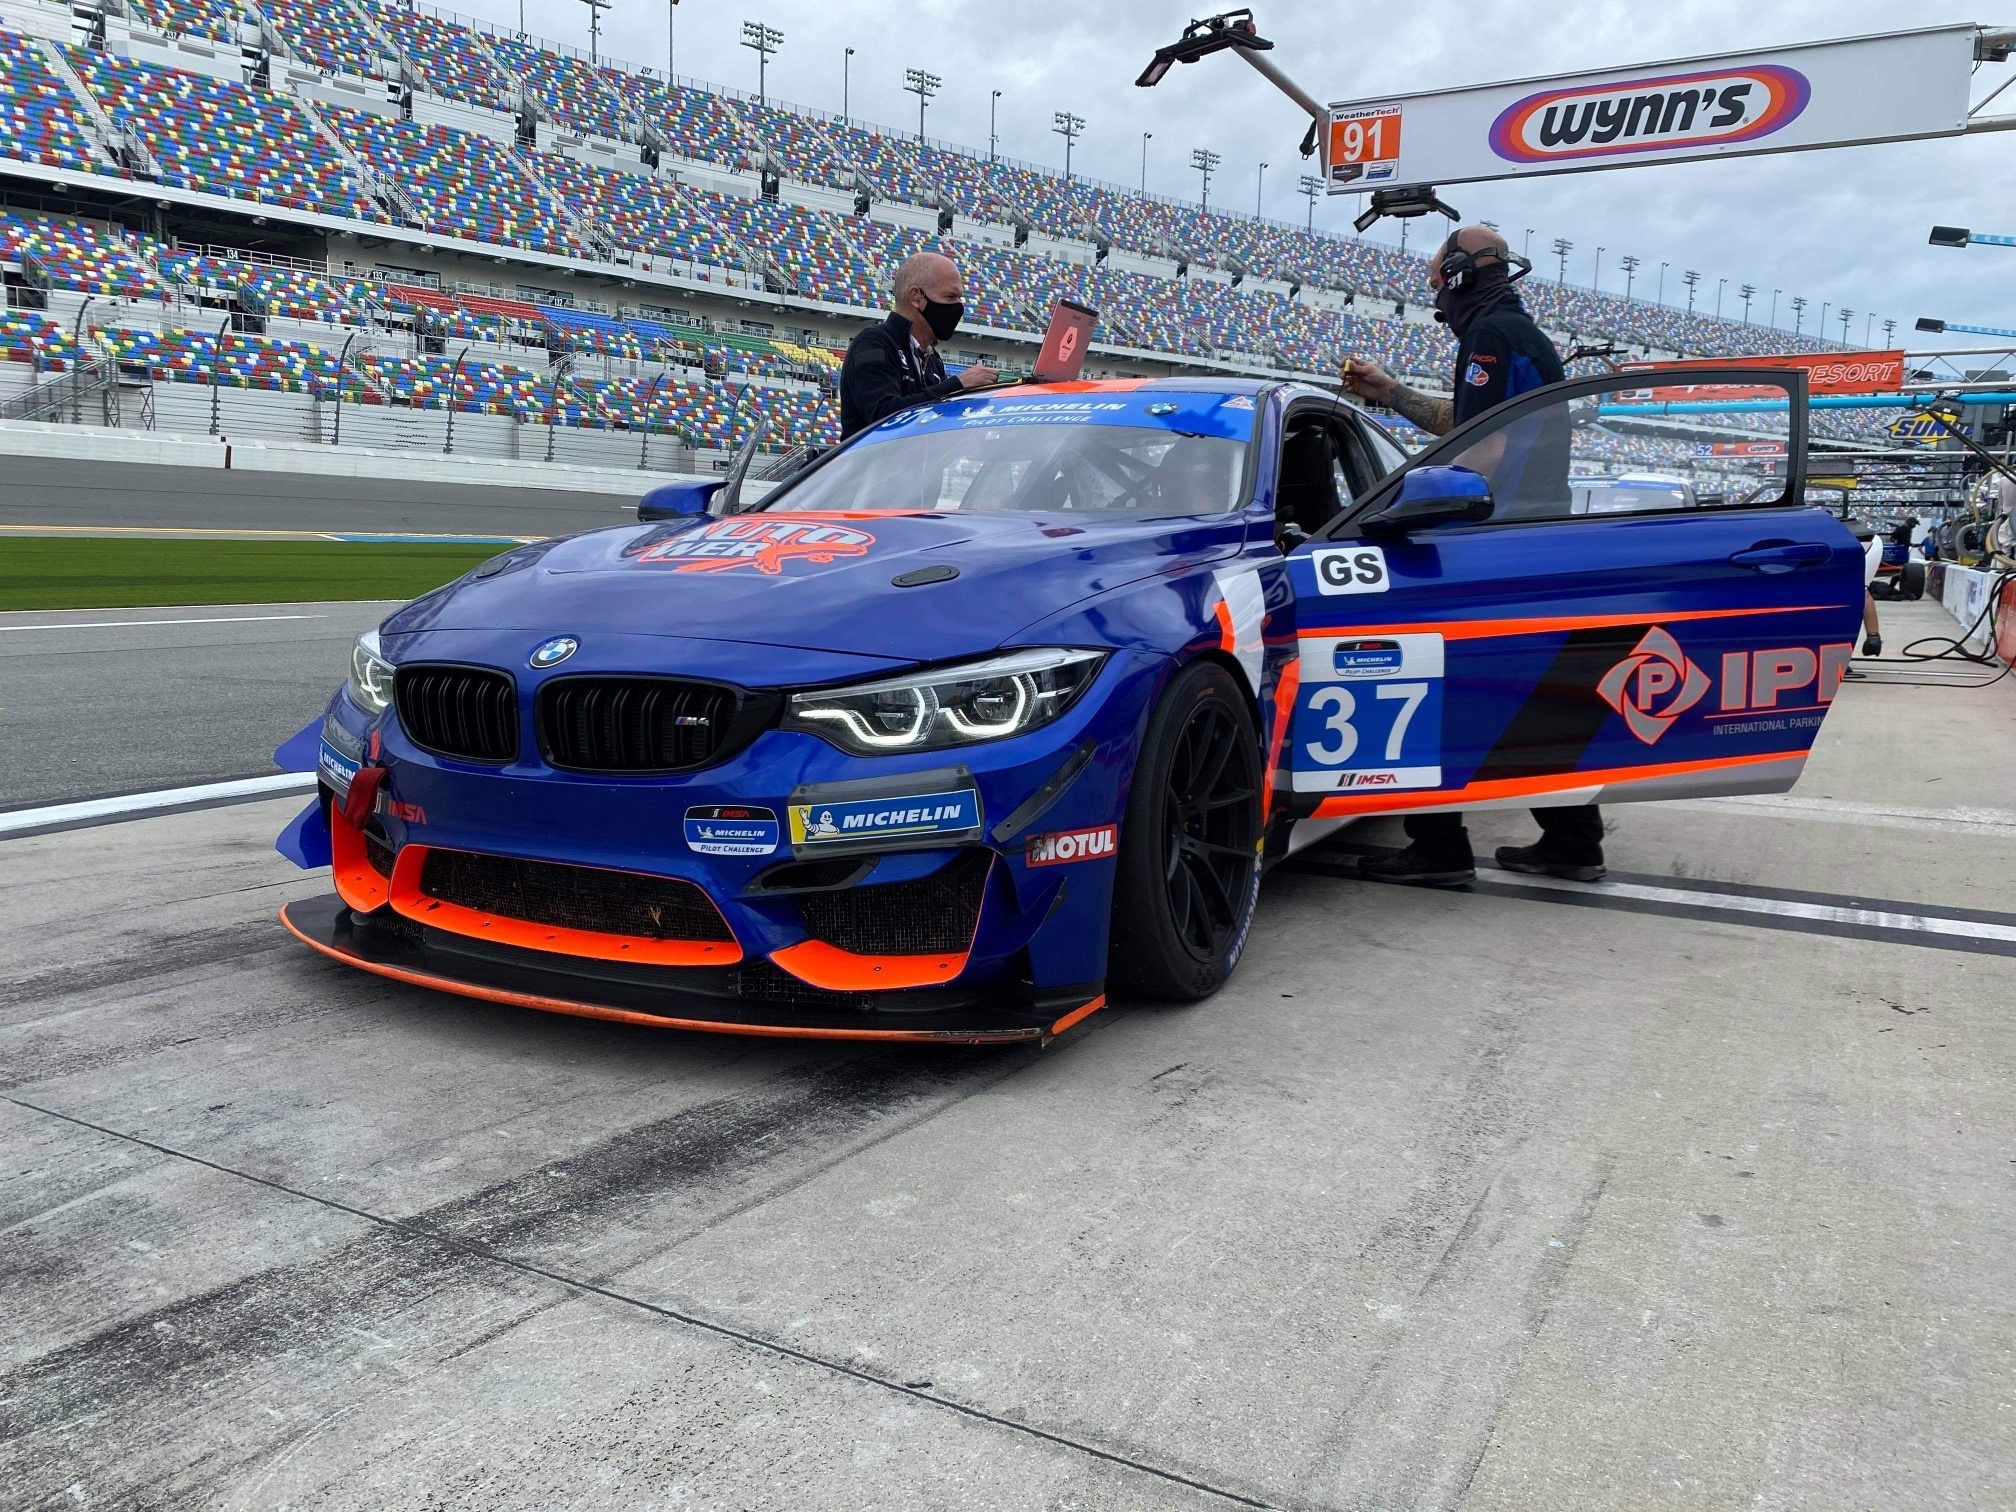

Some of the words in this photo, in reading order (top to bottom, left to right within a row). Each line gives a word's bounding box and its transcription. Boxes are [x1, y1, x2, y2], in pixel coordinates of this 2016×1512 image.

[1336, 107, 1398, 120] WeatherTech
[1343, 119, 1383, 162] 91
[227, 249, 239, 260] 134
[372, 270, 383, 281] 133
[1447, 271, 1464, 290] 31
[999, 403, 1126, 413] MICHELIN
[882, 407, 934, 428] 37
[963, 417, 1007, 427] PILOT
[1008, 415, 1092, 423] CHALLENGE
[1696, 444, 1713, 456] 52
[1320, 552, 1383, 587] GS
[1637, 662, 1677, 711] P
[684, 716, 710, 727] M4
[1306, 682, 1429, 765] 37
[1713, 720, 1788, 736] INTERNATIONAL
[324, 752, 356, 781] MICHELIN
[1356, 774, 1398, 786] IMSA
[388, 799, 428, 825] IMSA
[721, 809, 750, 818] IMSA
[842, 804, 962, 829] MICHELIN
[715, 829, 766, 837] MICHELIN
[700, 845, 721, 853] PILOT
[723, 845, 764, 854] CHALLENGE
[1033, 829, 1114, 862] MOTUL
[1229, 876, 1260, 968] MICHELIN
